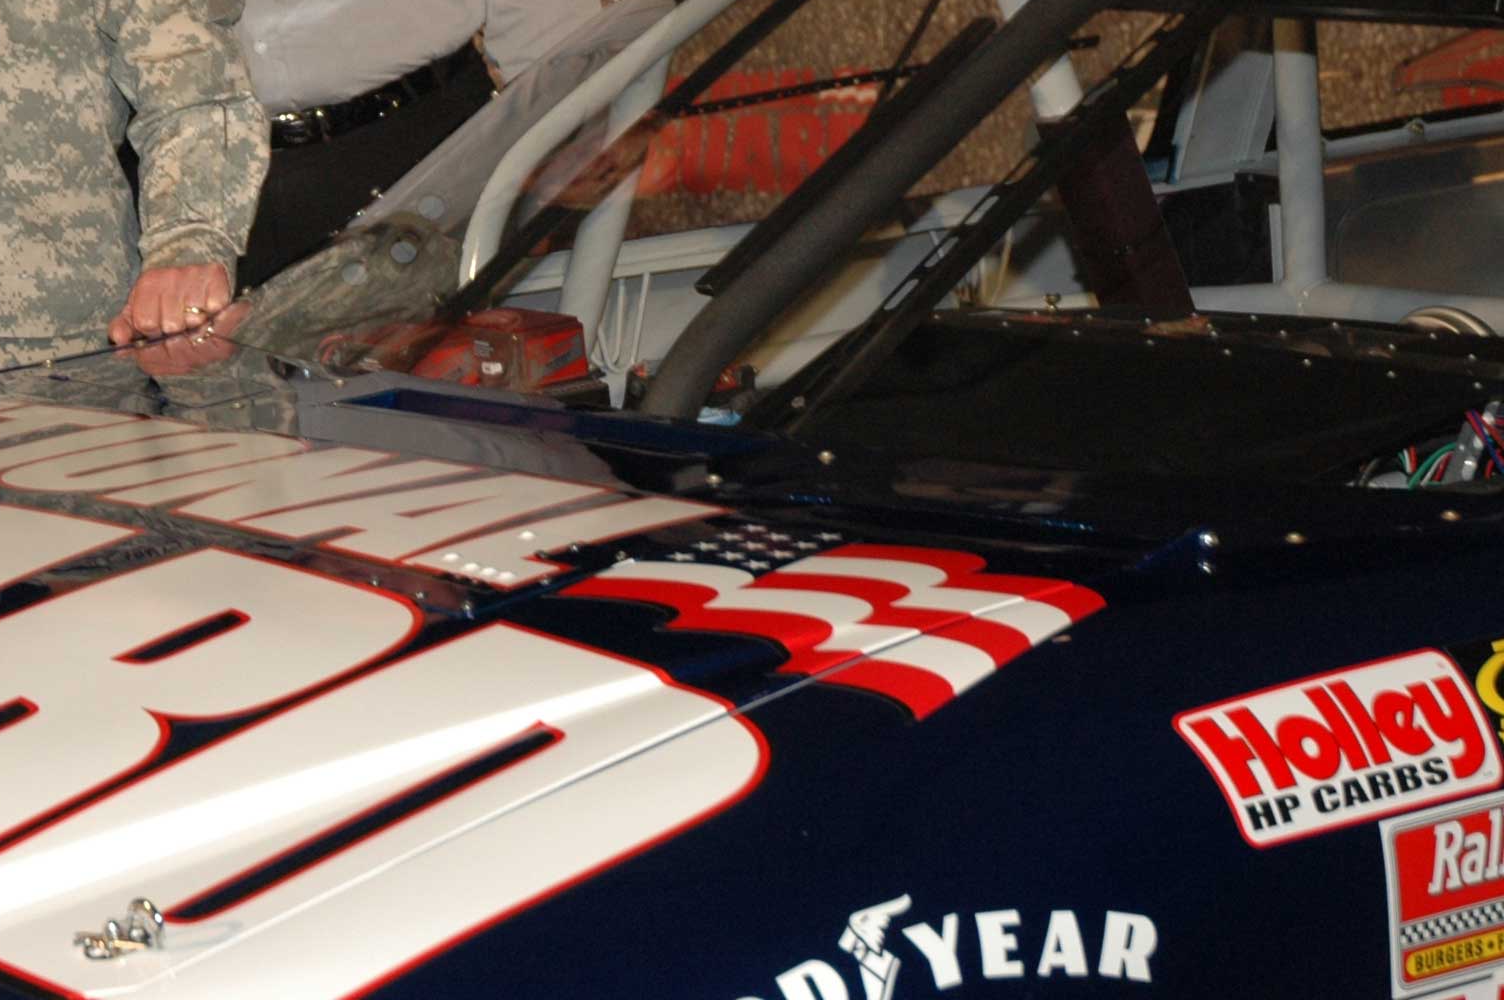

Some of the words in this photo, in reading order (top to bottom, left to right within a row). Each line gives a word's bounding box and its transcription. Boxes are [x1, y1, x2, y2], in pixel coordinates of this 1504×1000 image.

[1186, 676, 1486, 798] Holley
[1246, 794, 1299, 831] HP
[1310, 758, 1449, 815] CARBS
[1415, 938, 1483, 972] BURGERS
